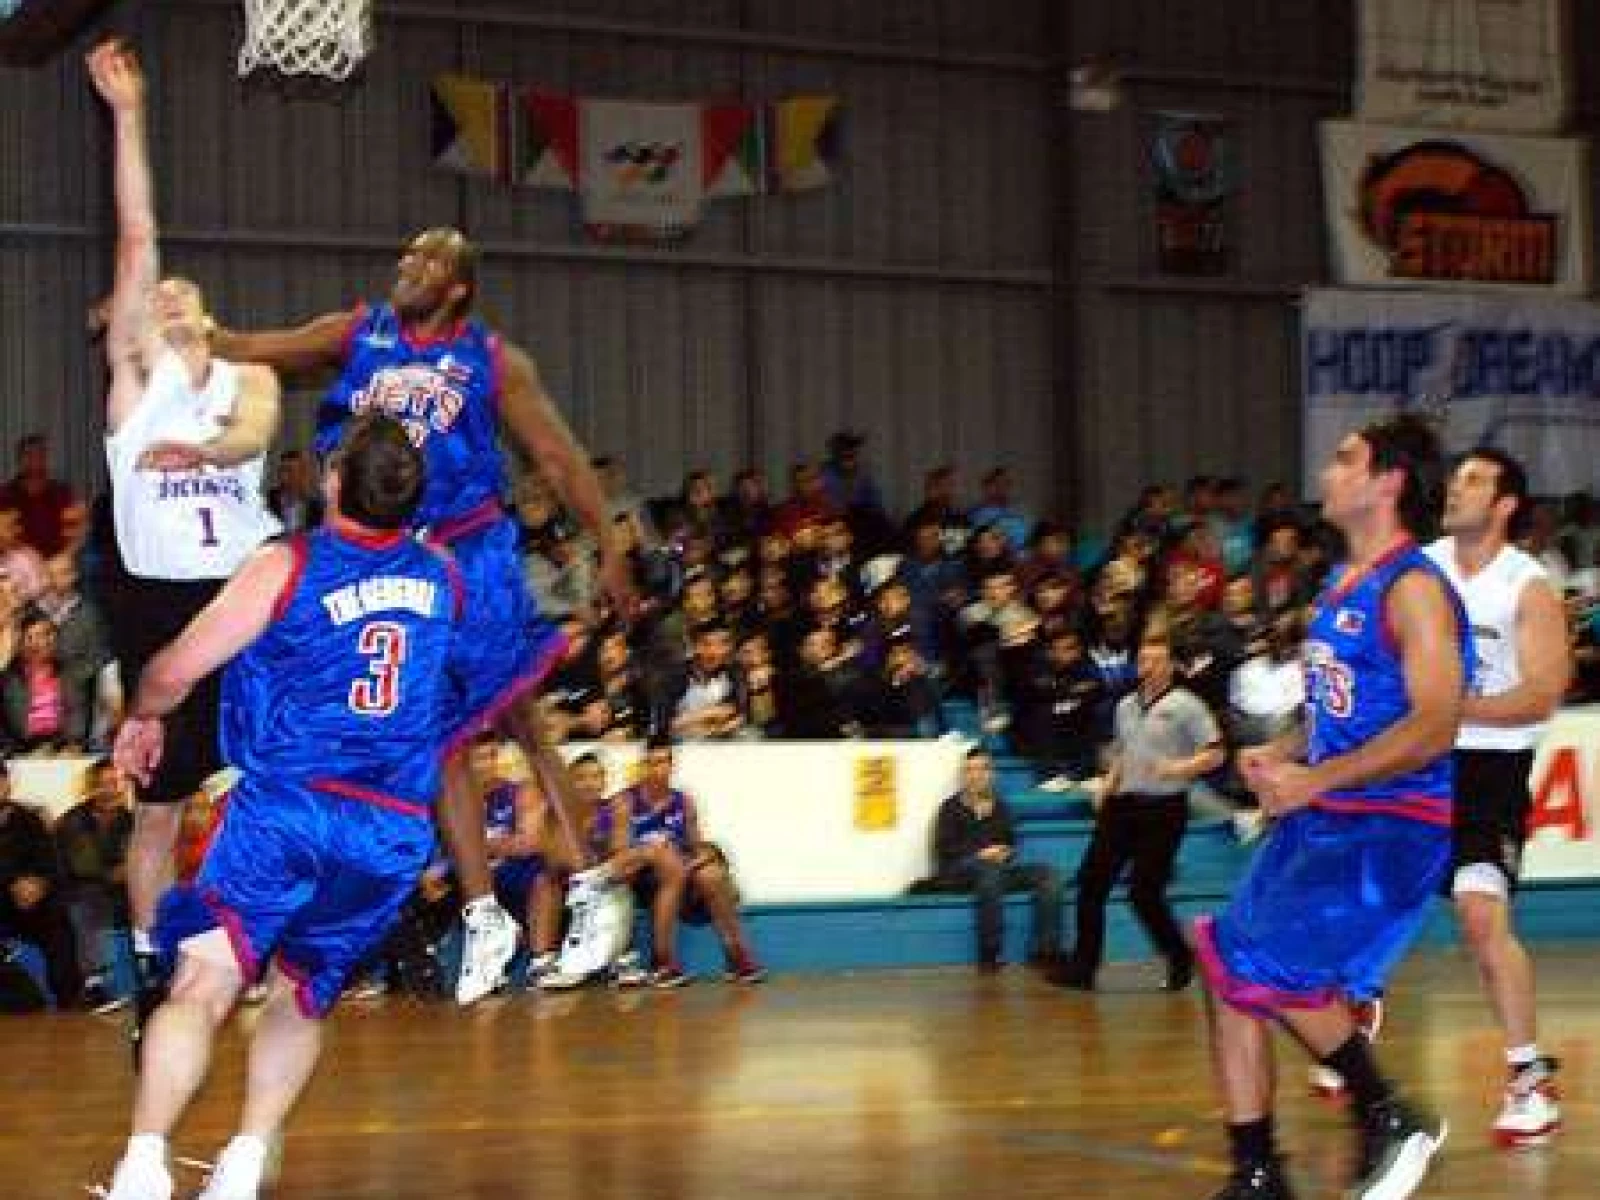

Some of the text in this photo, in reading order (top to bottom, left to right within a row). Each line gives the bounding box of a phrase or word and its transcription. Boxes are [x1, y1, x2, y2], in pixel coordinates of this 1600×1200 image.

[196, 507, 221, 547] 1
[348, 621, 407, 717] 3
[1524, 745, 1593, 840] A
